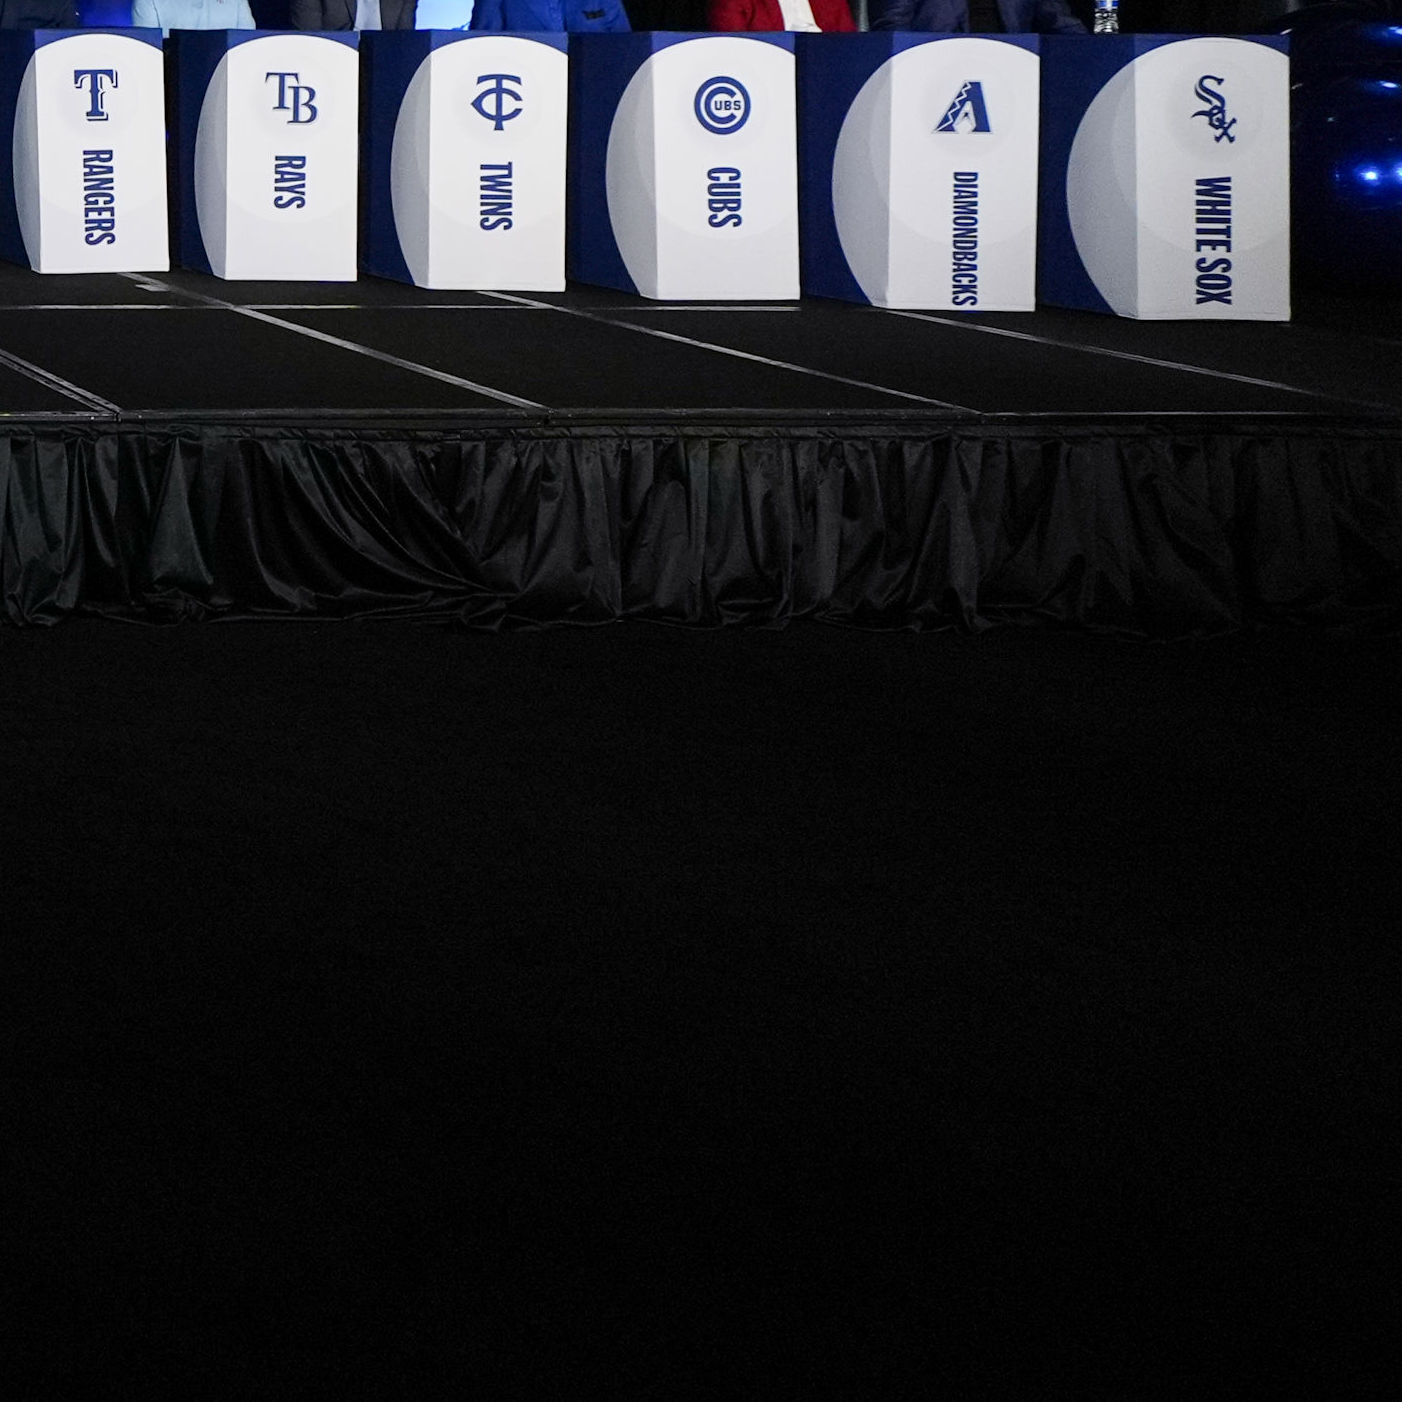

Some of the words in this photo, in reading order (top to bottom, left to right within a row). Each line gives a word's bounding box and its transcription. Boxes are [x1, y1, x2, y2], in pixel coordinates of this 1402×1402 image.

[73, 68, 119, 122] T
[264, 71, 318, 125] TB
[932, 80, 993, 134] A
[82, 149, 116, 246] RANGERS
[273, 155, 307, 209] RAYS
[479, 161, 513, 231] TWINS
[706, 166, 743, 229] CUBS
[951, 171, 979, 307] DIAMONDBACKS
[1195, 176, 1232, 252] WHITE
[1195, 257, 1232, 305] SOX
